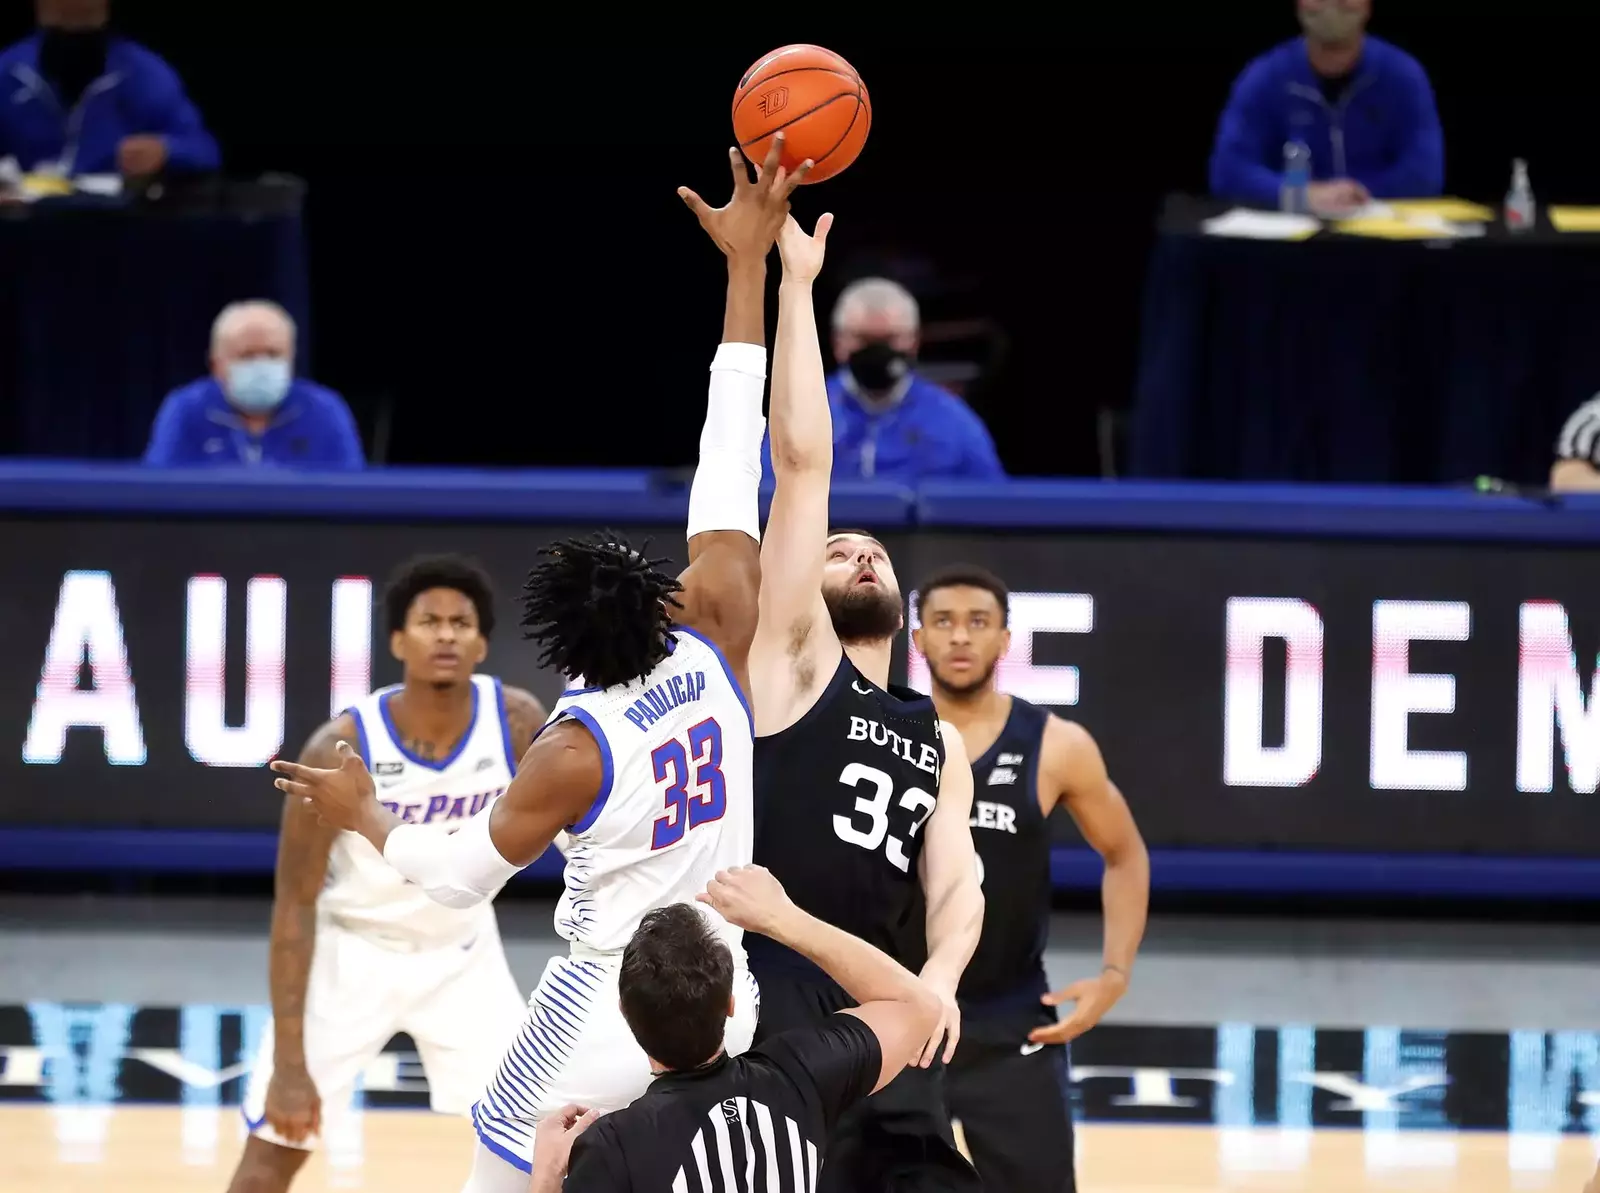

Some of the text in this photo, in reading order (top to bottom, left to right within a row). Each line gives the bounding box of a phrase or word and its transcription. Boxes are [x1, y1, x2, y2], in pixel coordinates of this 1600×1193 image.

[624, 671, 706, 733] PAULICAP
[650, 716, 727, 850] 33
[847, 716, 940, 787] BUTLE
[833, 762, 936, 873] 33
